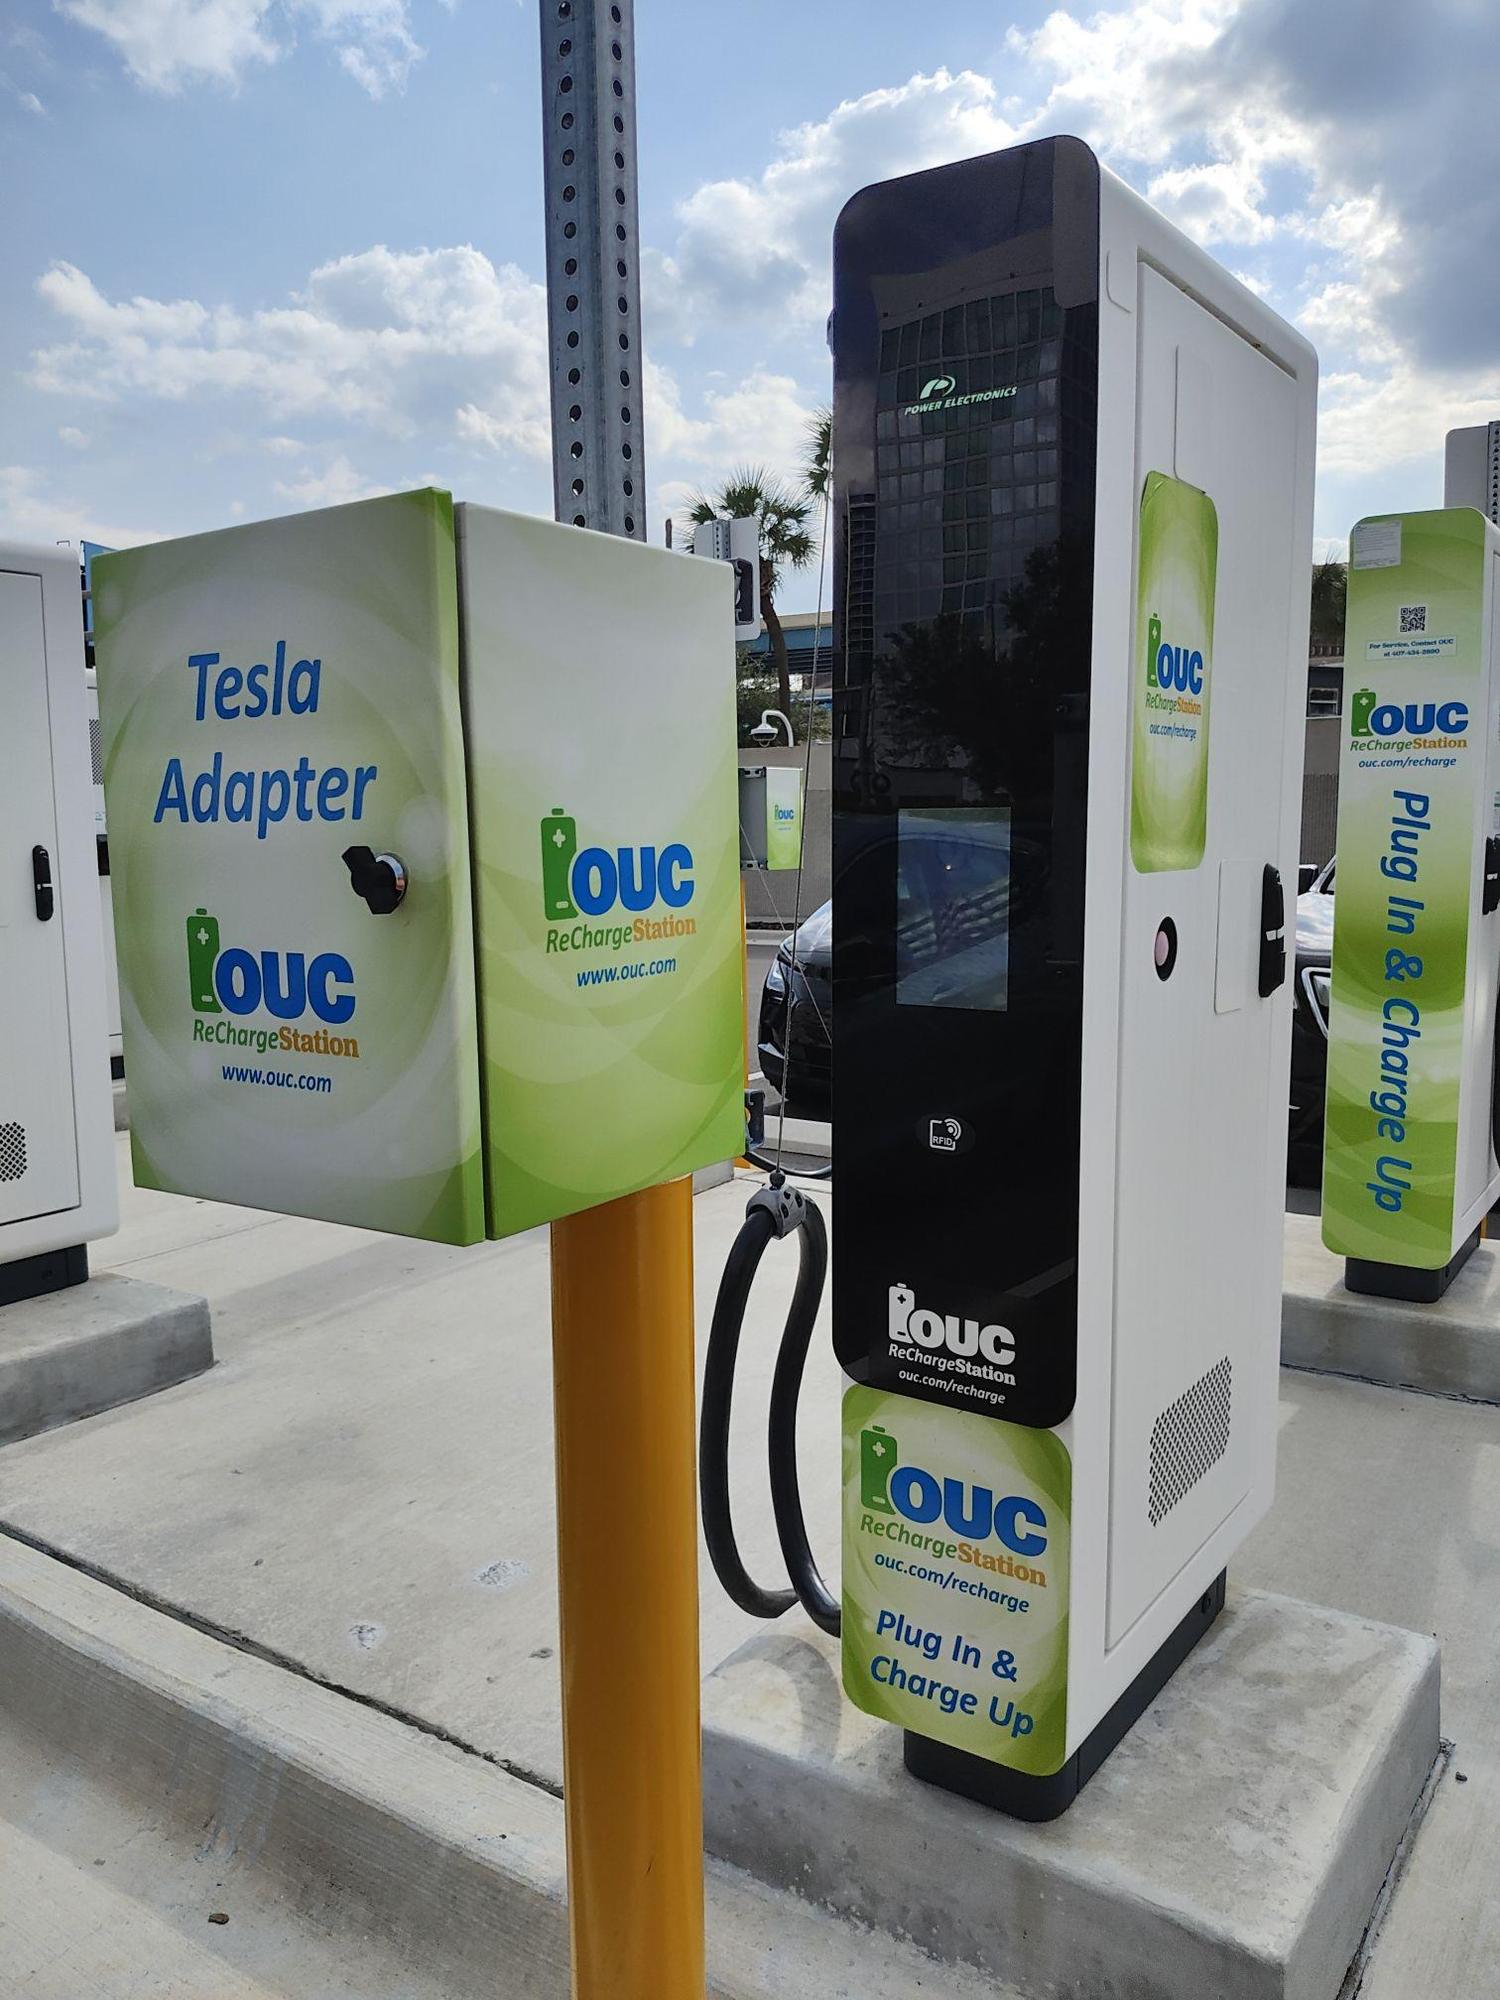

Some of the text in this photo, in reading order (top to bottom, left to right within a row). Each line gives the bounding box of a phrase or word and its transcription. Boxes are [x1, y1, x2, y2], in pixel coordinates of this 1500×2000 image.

[904, 386, 1018, 416] POWER ELECTRONICS
[187, 640, 322, 721] Tesla
[1157, 643, 1203, 695] OUC
[1150, 722, 1197, 742] ouc.com/recharge
[1370, 701, 1469, 736] OUC
[1350, 738, 1467, 752] ReChargeStation
[1358, 756, 1457, 768] ouc.com/recharge
[153, 752, 377, 840] Adapter
[571, 842, 696, 916] OUC
[545, 915, 697, 954] ReChargeStation
[215, 950, 356, 1024] OUC
[576, 956, 677, 987] www.ouc.com
[1366, 790, 1431, 1212] Plug In & Charge Up
[192, 1019, 360, 1058] ReChargeStation
[221, 1063, 332, 1093] www.ouc.com
[933, 1136, 953, 1146] RFID
[908, 1307, 1016, 1366] OUC
[888, 1342, 1016, 1387] ReChargeStation
[898, 1368, 1006, 1404] ouc.com/recharge
[890, 1466, 1048, 1557] OUC
[860, 1514, 1047, 1588] ReChargeStation
[874, 1551, 1030, 1613] ouc.com/recharge
[875, 1609, 1018, 1683] Plug In &
[870, 1655, 1034, 1738] Charge Up
